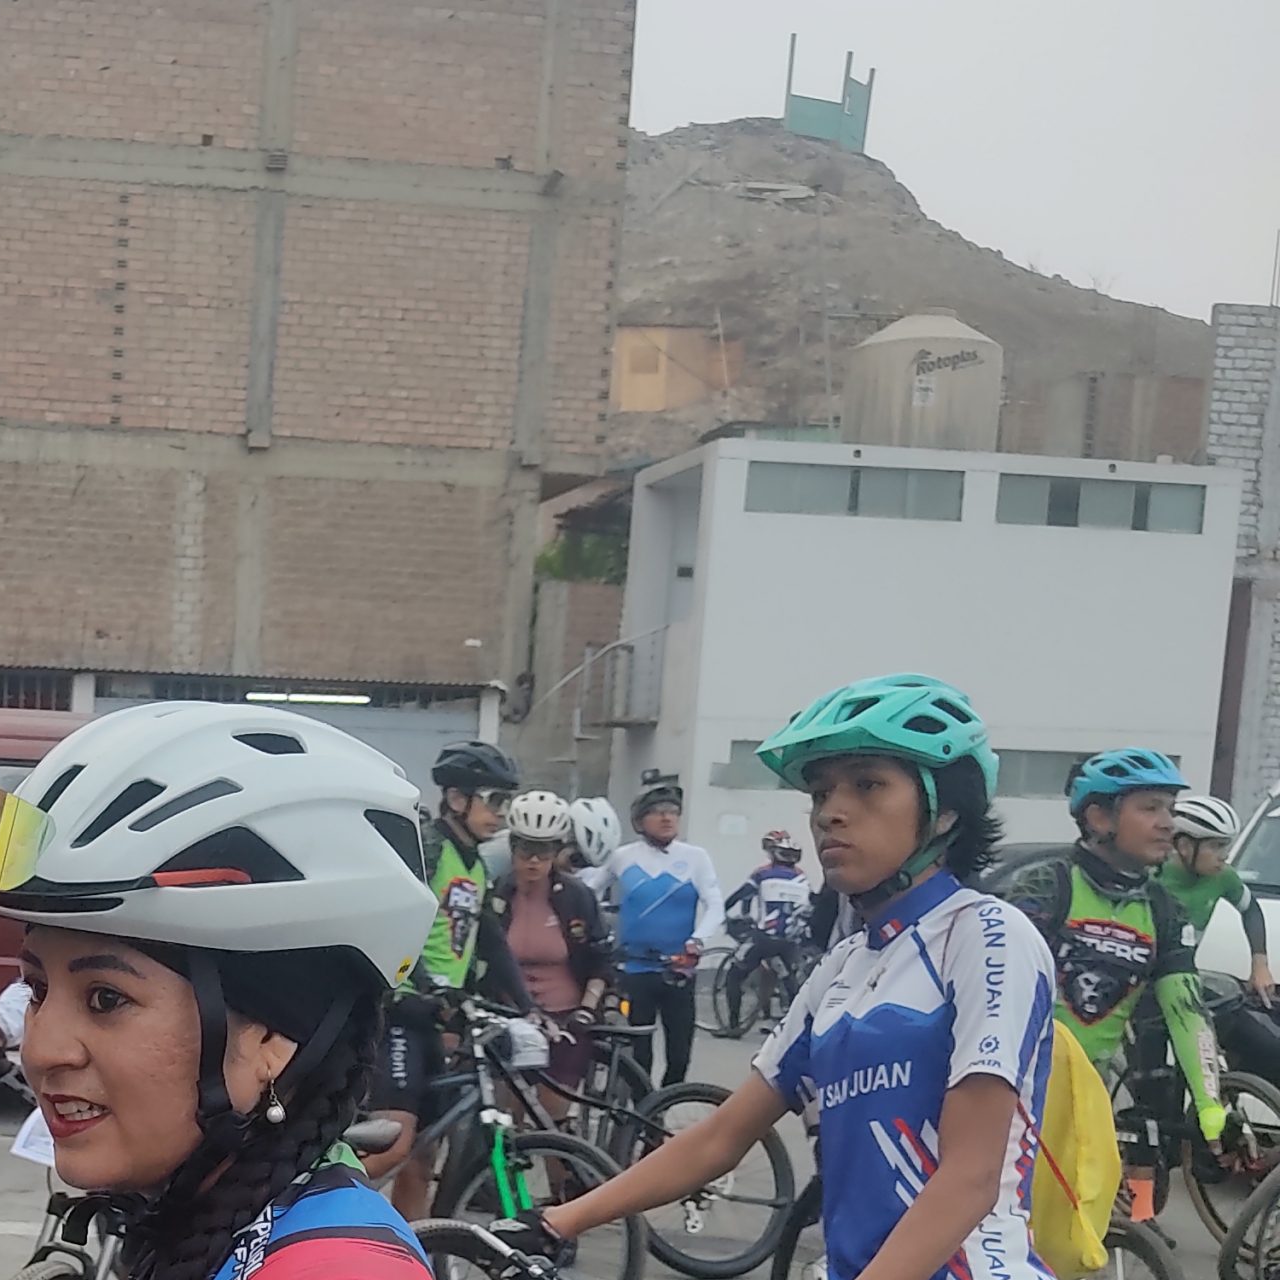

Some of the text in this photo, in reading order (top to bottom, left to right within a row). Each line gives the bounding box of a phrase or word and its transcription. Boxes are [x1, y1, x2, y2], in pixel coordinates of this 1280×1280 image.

[916, 350, 978, 376] Rotoplas
[978, 906, 1006, 948] SAN
[849, 1060, 911, 1097] JUAN
